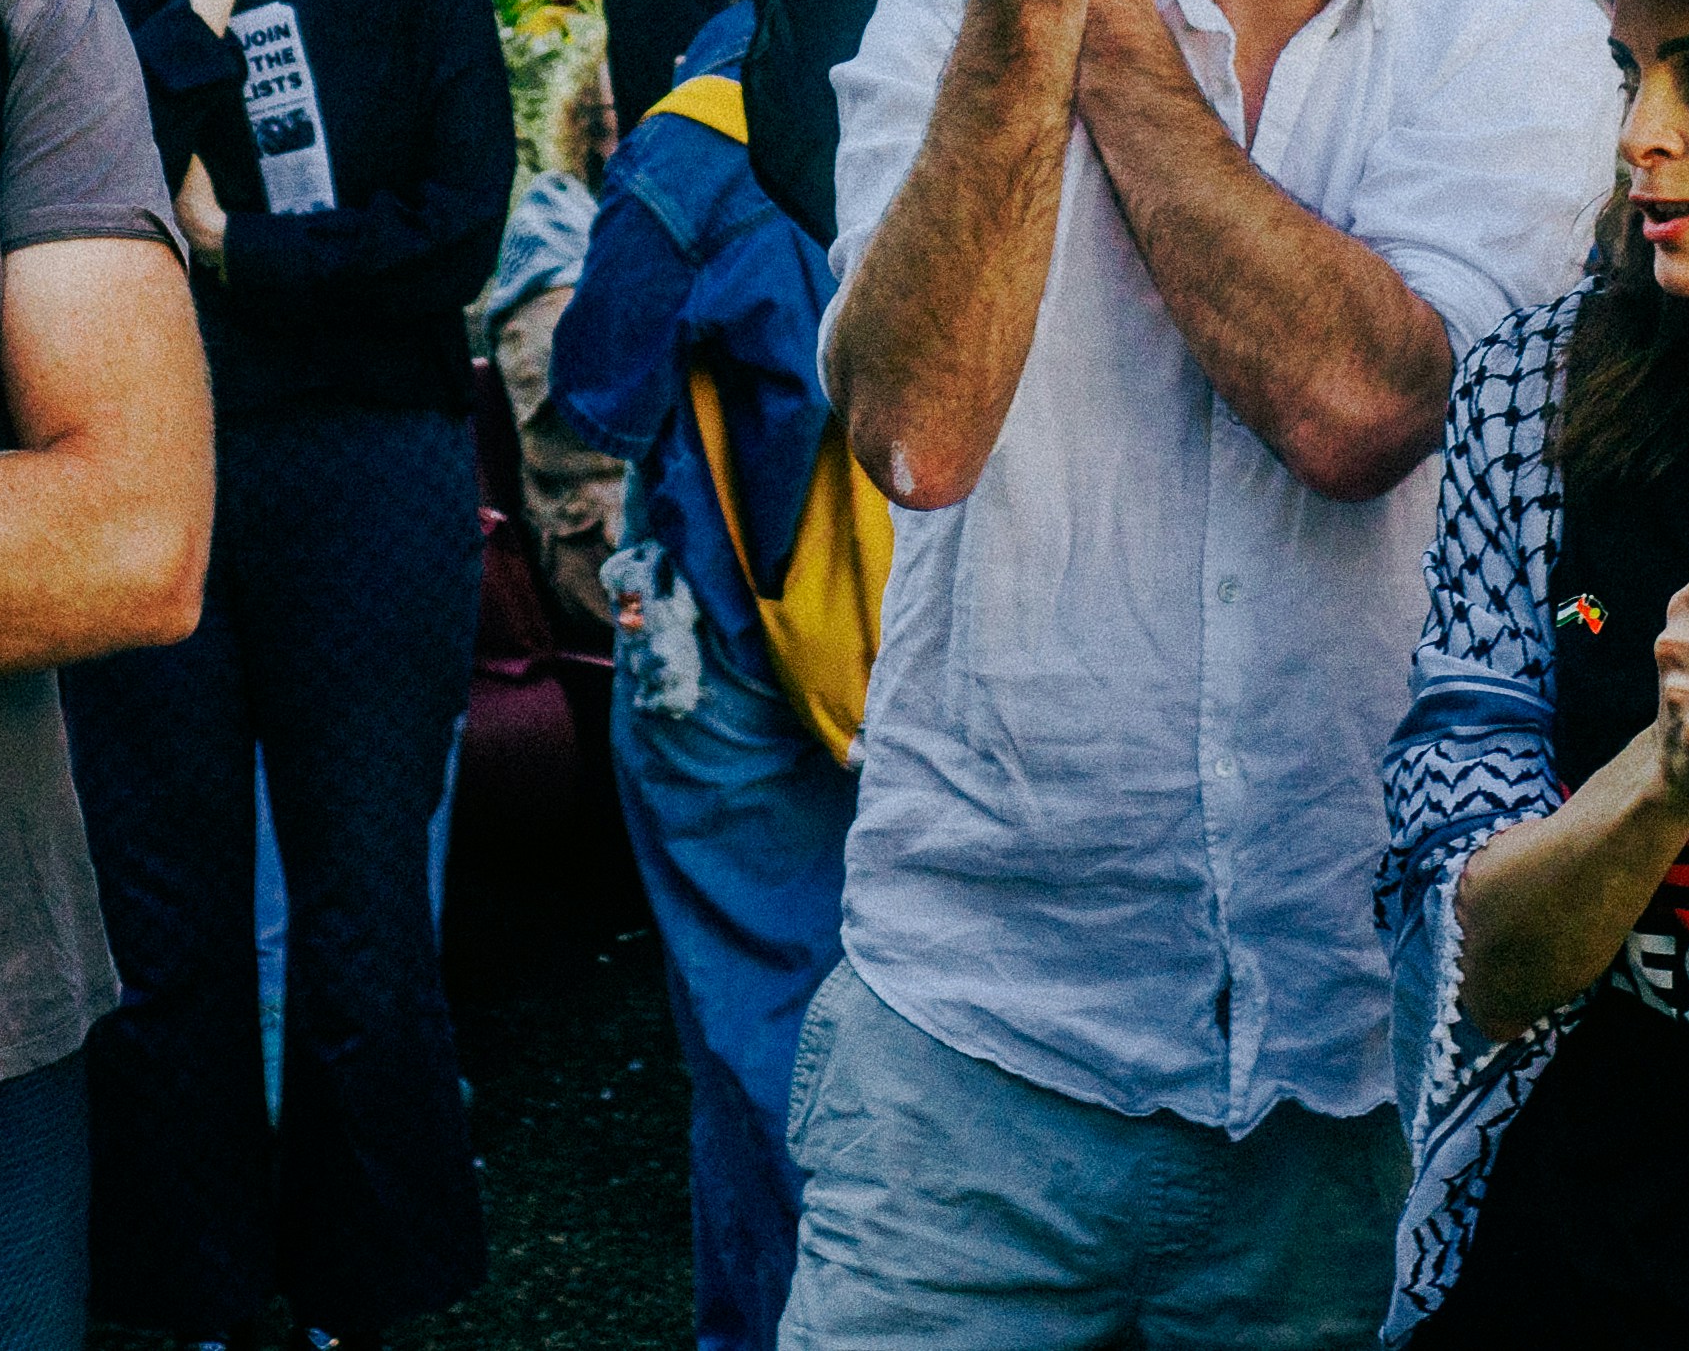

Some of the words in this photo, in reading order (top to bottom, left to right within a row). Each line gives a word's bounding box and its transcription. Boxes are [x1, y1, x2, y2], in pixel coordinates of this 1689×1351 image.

[243, 23, 291, 51] JOIN
[249, 45, 297, 73] THE
[245, 71, 303, 103] ISTS
